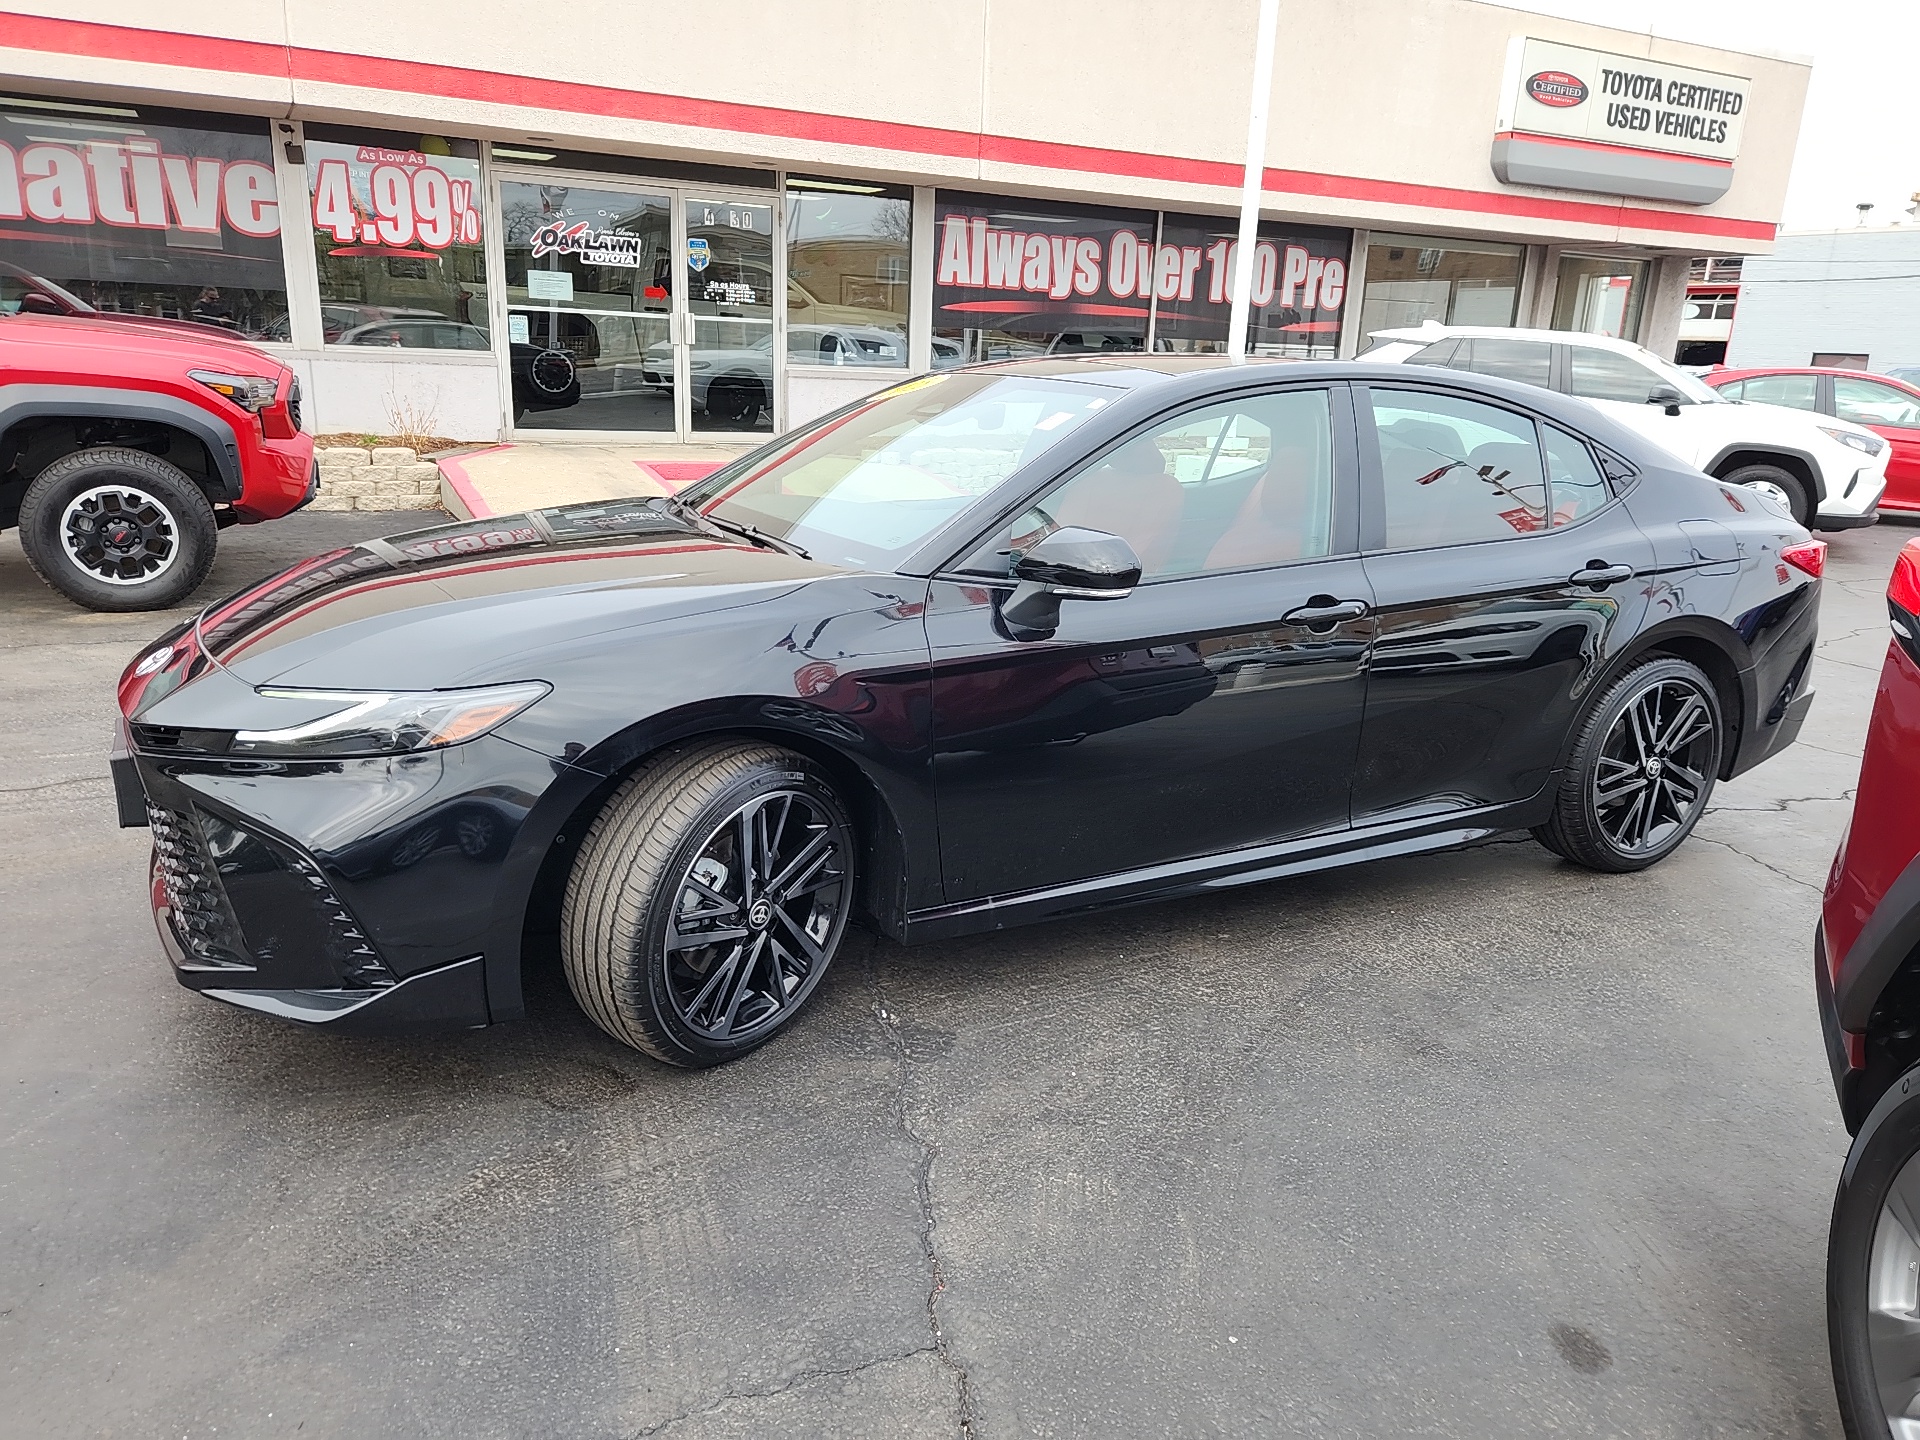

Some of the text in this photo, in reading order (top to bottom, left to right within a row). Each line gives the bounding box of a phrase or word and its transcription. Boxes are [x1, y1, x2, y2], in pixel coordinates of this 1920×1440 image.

[1533, 80, 1581, 97] CERTIFIED
[1602, 69, 1743, 115] TOYOTA CERTIFIED
[1606, 102, 1727, 143] USED VEHICLES
[360, 149, 424, 164] As Low As
[313, 159, 481, 249] 4.99%
[588, 252, 635, 265] TOYOTA
[938, 214, 1101, 299] Always
[1108, 229, 1201, 300] Over
[1280, 244, 1346, 311] Pre
